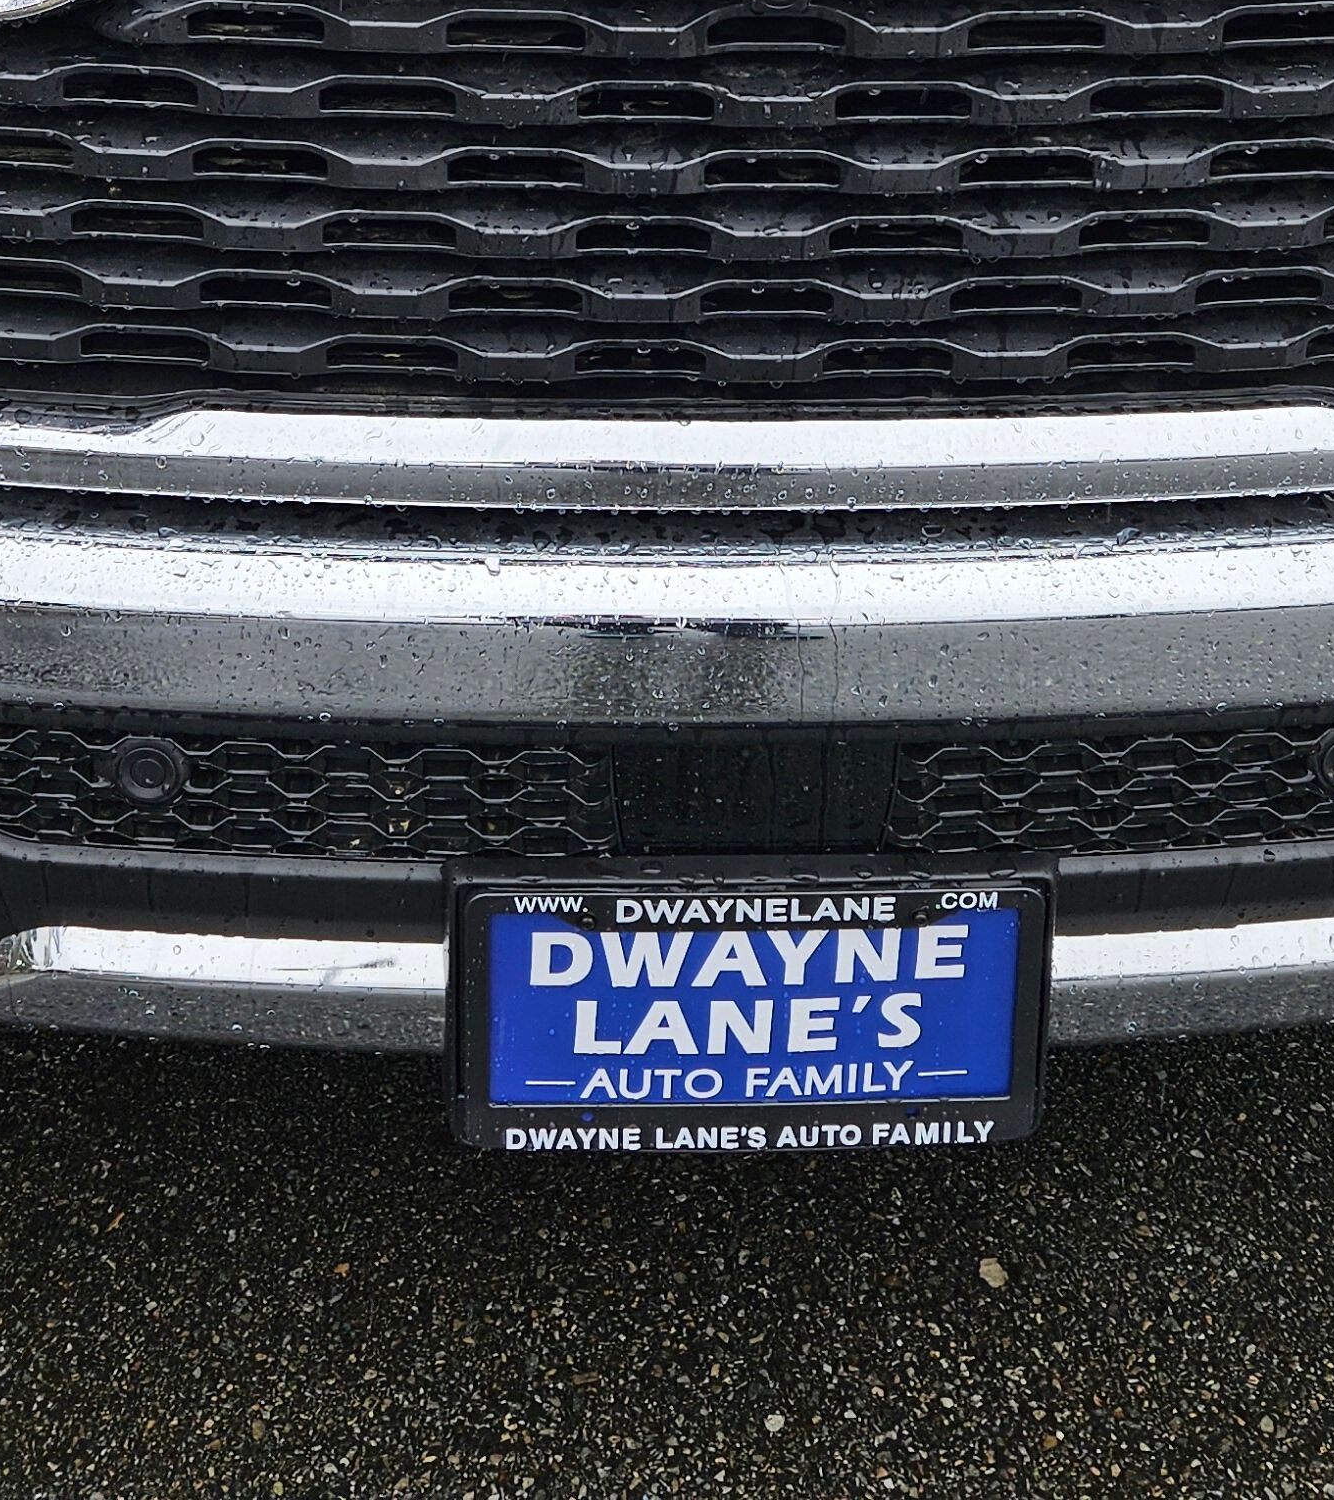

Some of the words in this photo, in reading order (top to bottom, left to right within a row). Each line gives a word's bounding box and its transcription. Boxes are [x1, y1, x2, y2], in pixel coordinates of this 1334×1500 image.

[513, 896, 589, 914] WWW.
[616, 896, 897, 924] DWAYNELANE
[935, 891, 999, 910] .COM
[529, 924, 969, 988] DWAYNE
[573, 992, 922, 1055] LANE'S
[579, 1067, 723, 1100] AUTO
[745, 1060, 915, 1098] FAMILY
[504, 1127, 642, 1151] DWAYNE
[655, 1126, 767, 1150] LANE'S
[776, 1124, 862, 1148] AUTO
[872, 1120, 995, 1146] FAMILY
